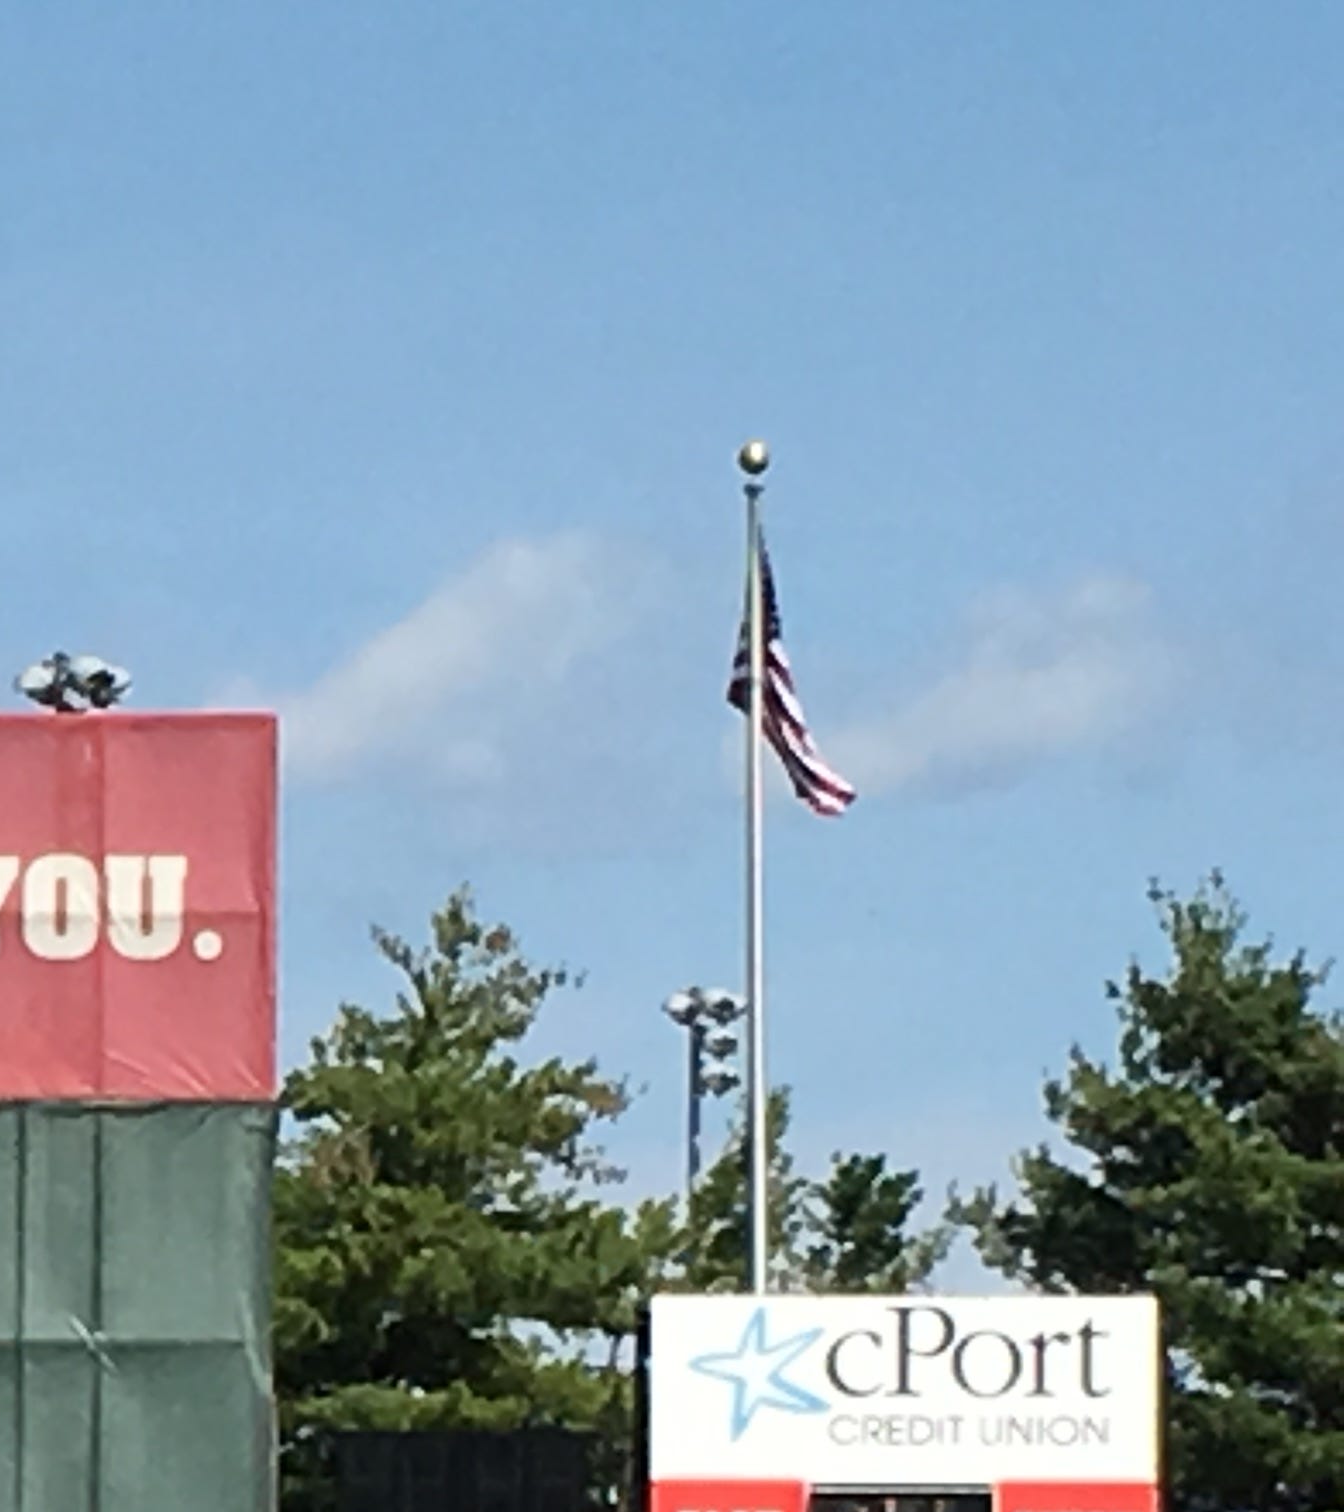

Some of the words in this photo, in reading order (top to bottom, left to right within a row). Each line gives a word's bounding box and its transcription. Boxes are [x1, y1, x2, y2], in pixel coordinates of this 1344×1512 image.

[826, 1305, 1111, 1398] cPort
[827, 1413, 964, 1446] CREDIT
[978, 1413, 1110, 1446] UNION
